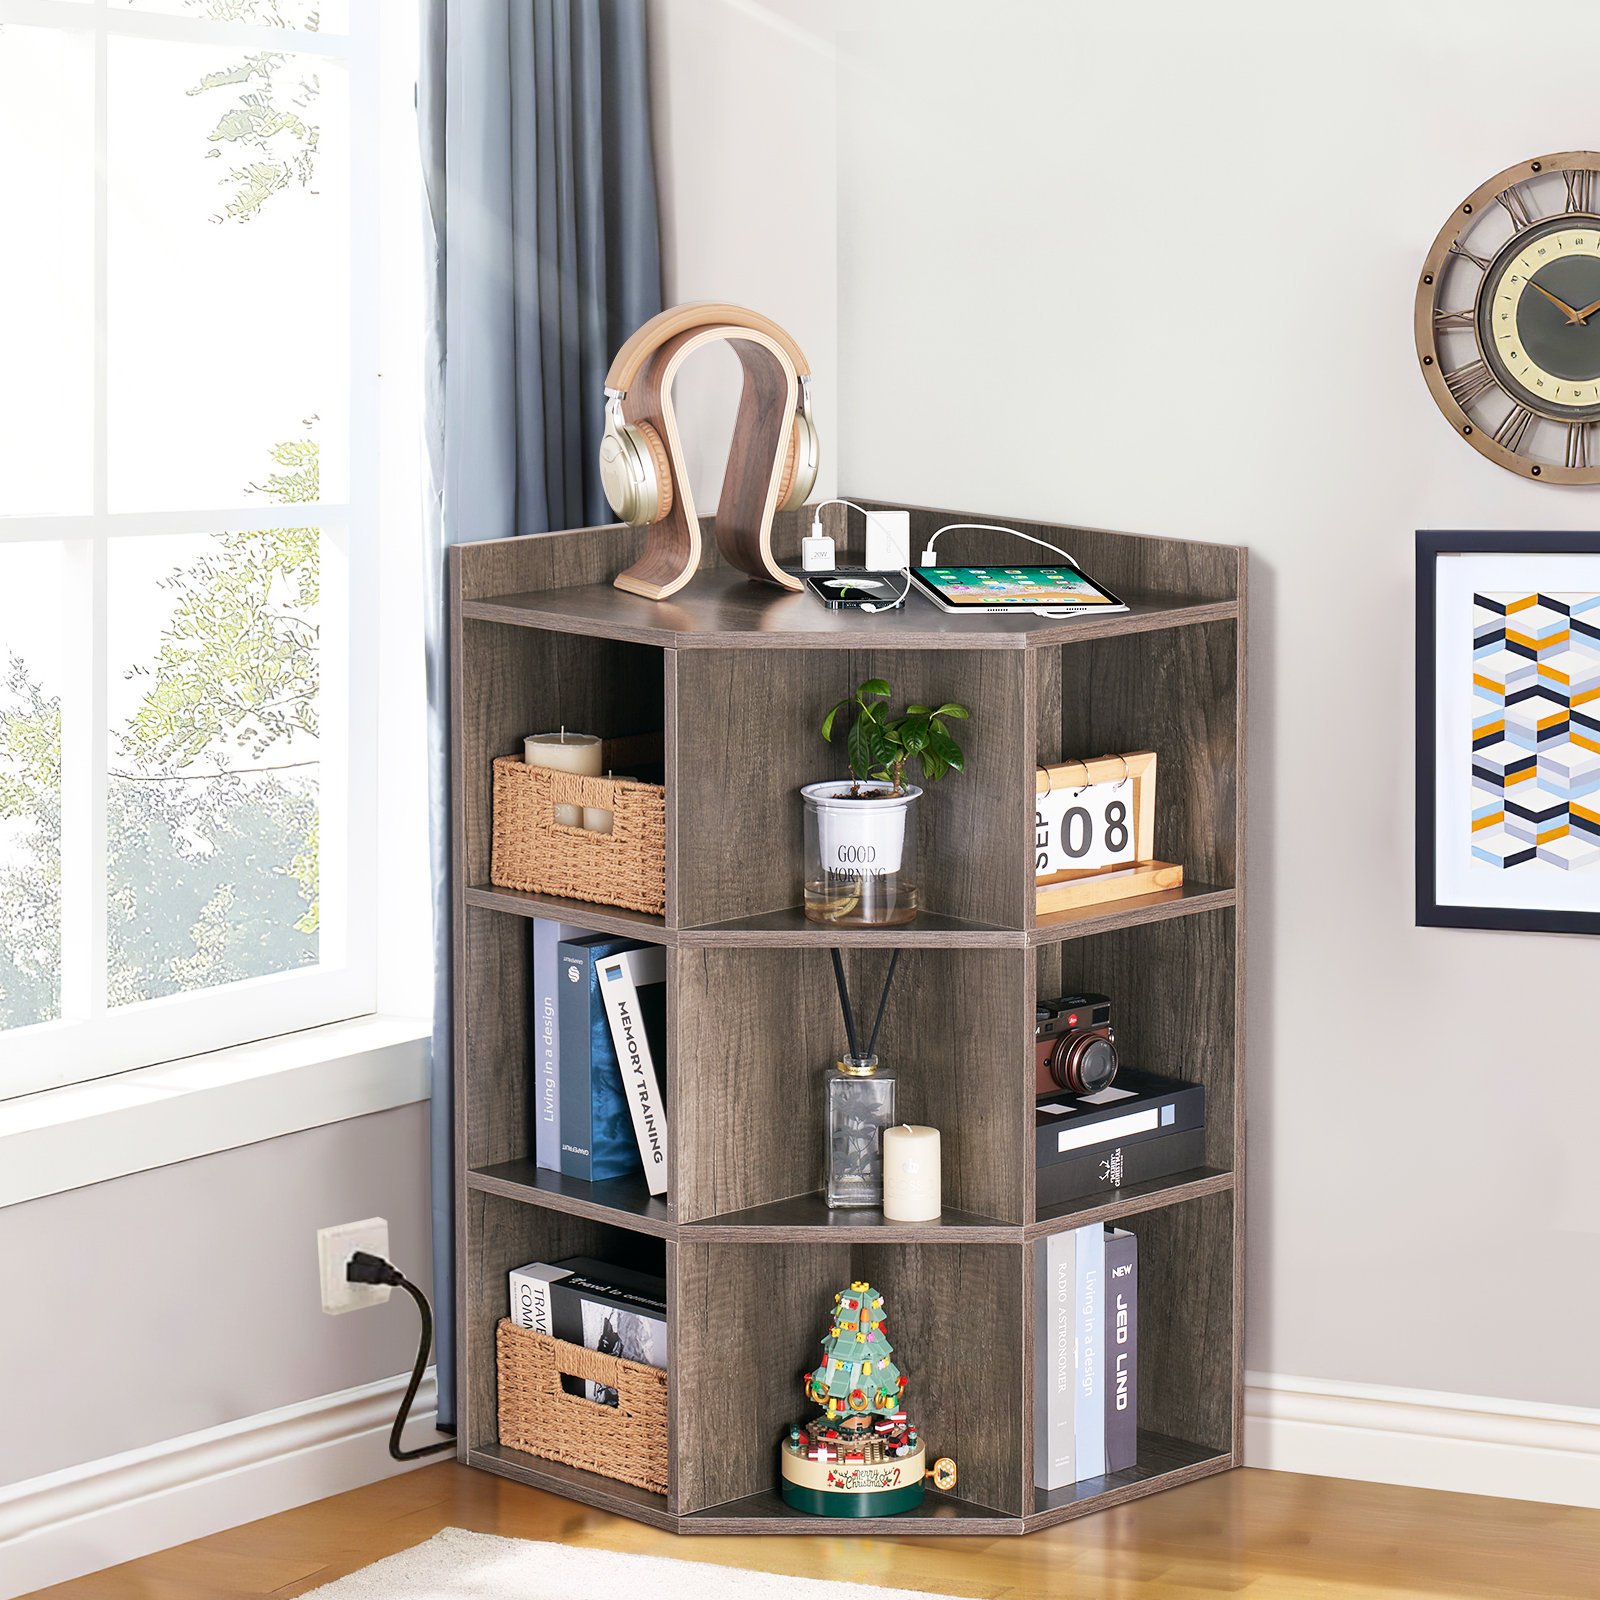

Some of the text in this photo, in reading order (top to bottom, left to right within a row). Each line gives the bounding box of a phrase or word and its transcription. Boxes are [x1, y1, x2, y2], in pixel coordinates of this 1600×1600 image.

[837, 844, 876, 863] GOOD
[1036, 811, 1049, 870] SEP
[1060, 800, 1129, 859] 08
[828, 866, 886, 883] MORNING
[542, 997, 556, 1122] Living in a design
[617, 1001, 664, 1165] MEMORY TRAINING
[1111, 1263, 1133, 1279] NEW
[1057, 1262, 1067, 1394] RADIO ASTRONOMER
[1082, 1270, 1097, 1398] Living in a design
[1116, 1293, 1128, 1411] JED LIND
